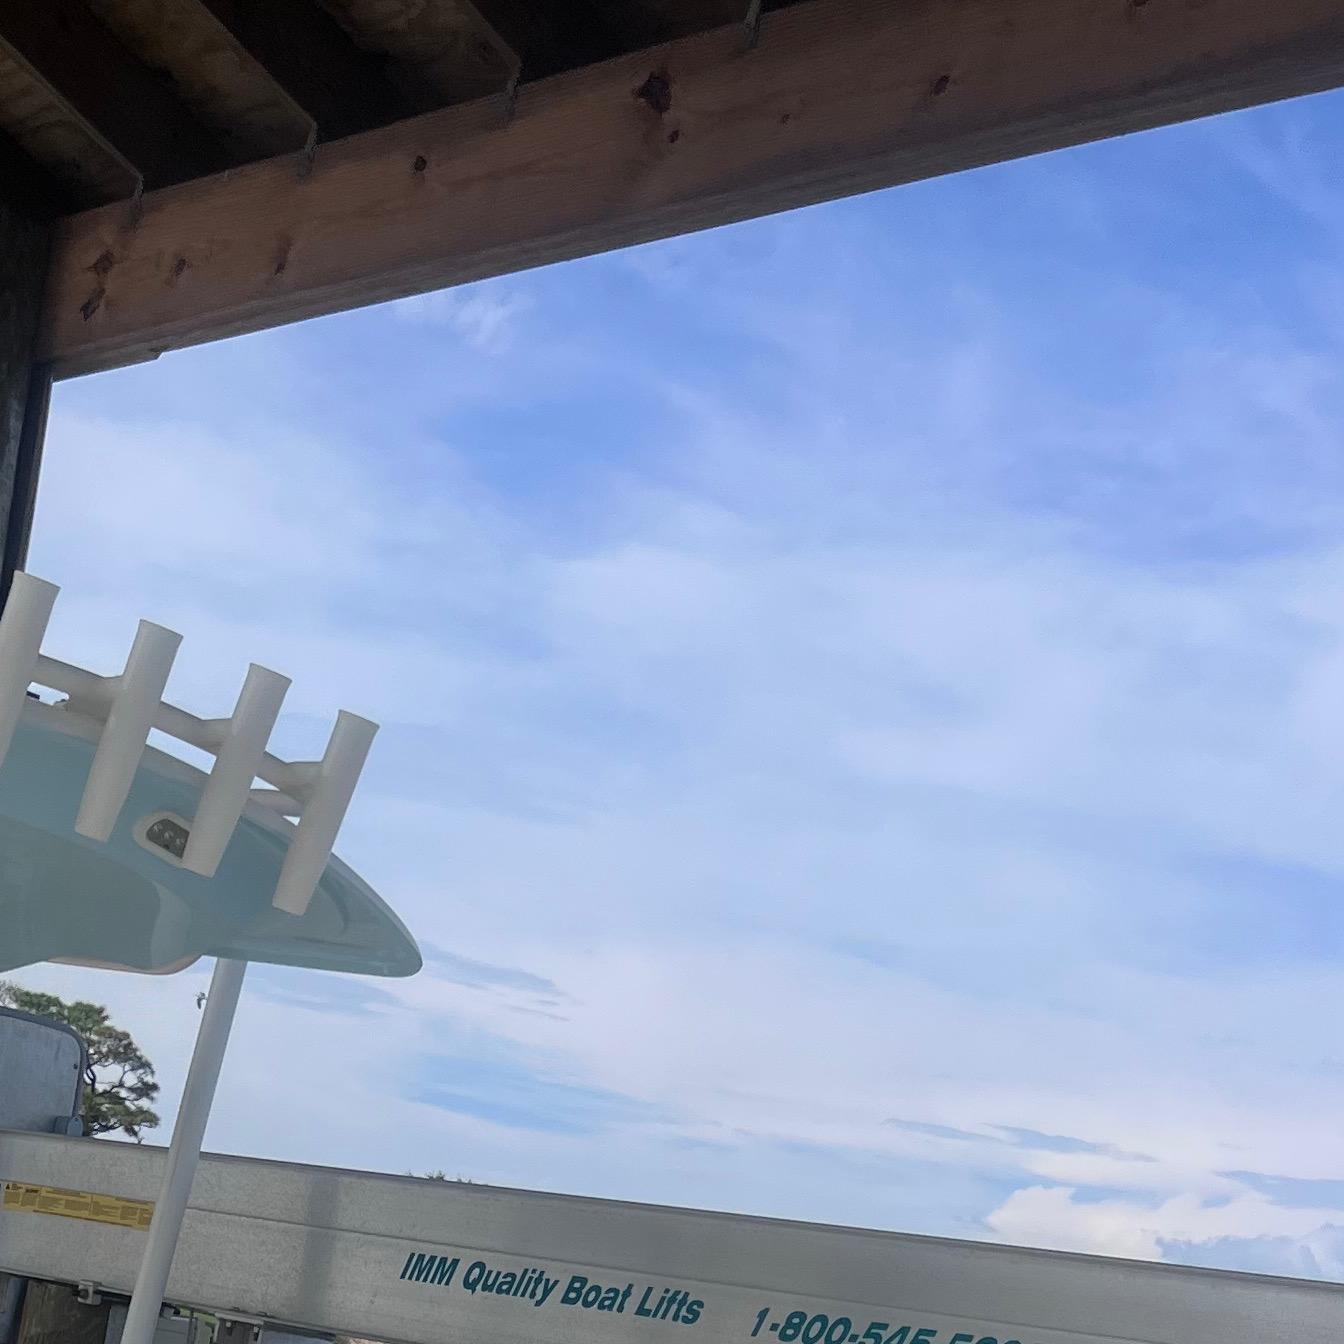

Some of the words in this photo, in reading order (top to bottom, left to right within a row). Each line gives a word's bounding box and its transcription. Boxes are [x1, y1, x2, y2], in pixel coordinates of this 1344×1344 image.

[399, 1251, 461, 1287] IMM
[461, 1260, 560, 1307] Quality
[559, 1275, 634, 1314] Boat
[633, 1286, 705, 1326] Lifts
